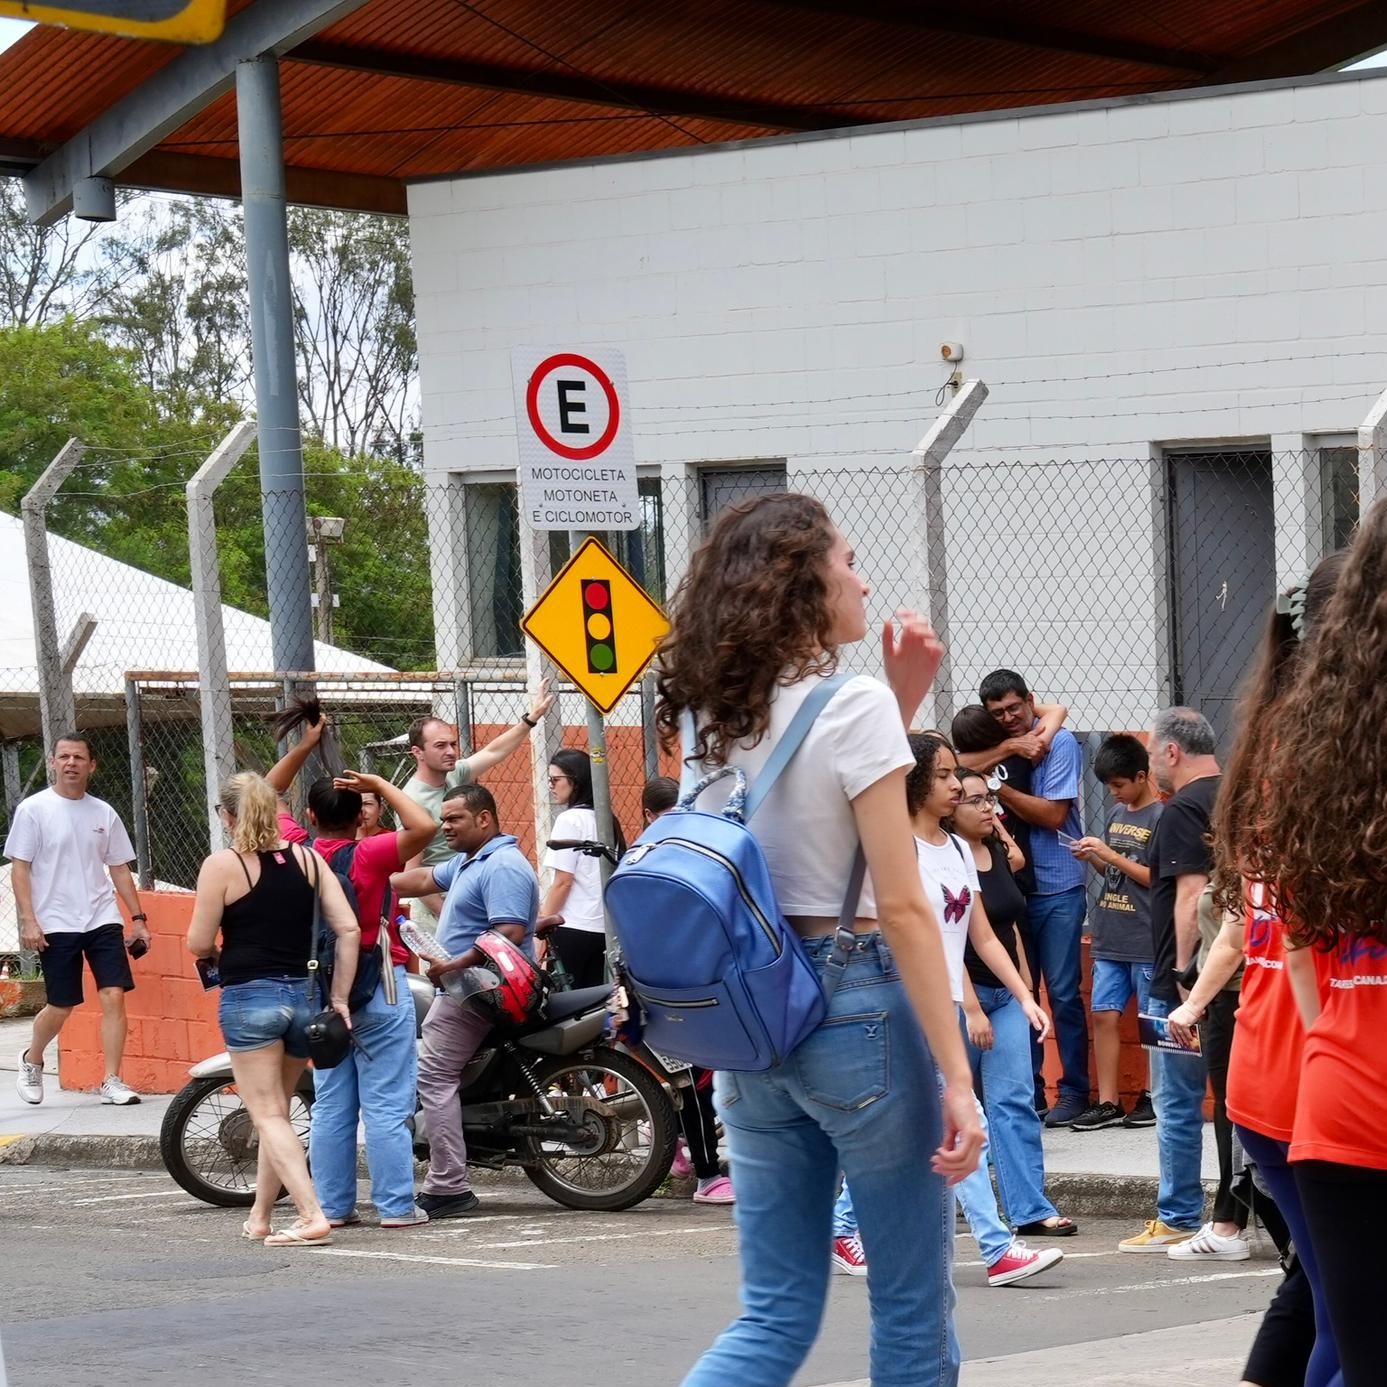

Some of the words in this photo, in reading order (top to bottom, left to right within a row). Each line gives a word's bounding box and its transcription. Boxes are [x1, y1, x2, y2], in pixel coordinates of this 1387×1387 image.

[557, 380, 589, 434] E
[532, 467, 626, 481] MOTOCICLETA
[544, 489, 618, 502] MOTONETA
[532, 510, 541, 522] E
[545, 510, 633, 523] CICLOMOTOR
[1109, 823, 1152, 840] NIVERSE
